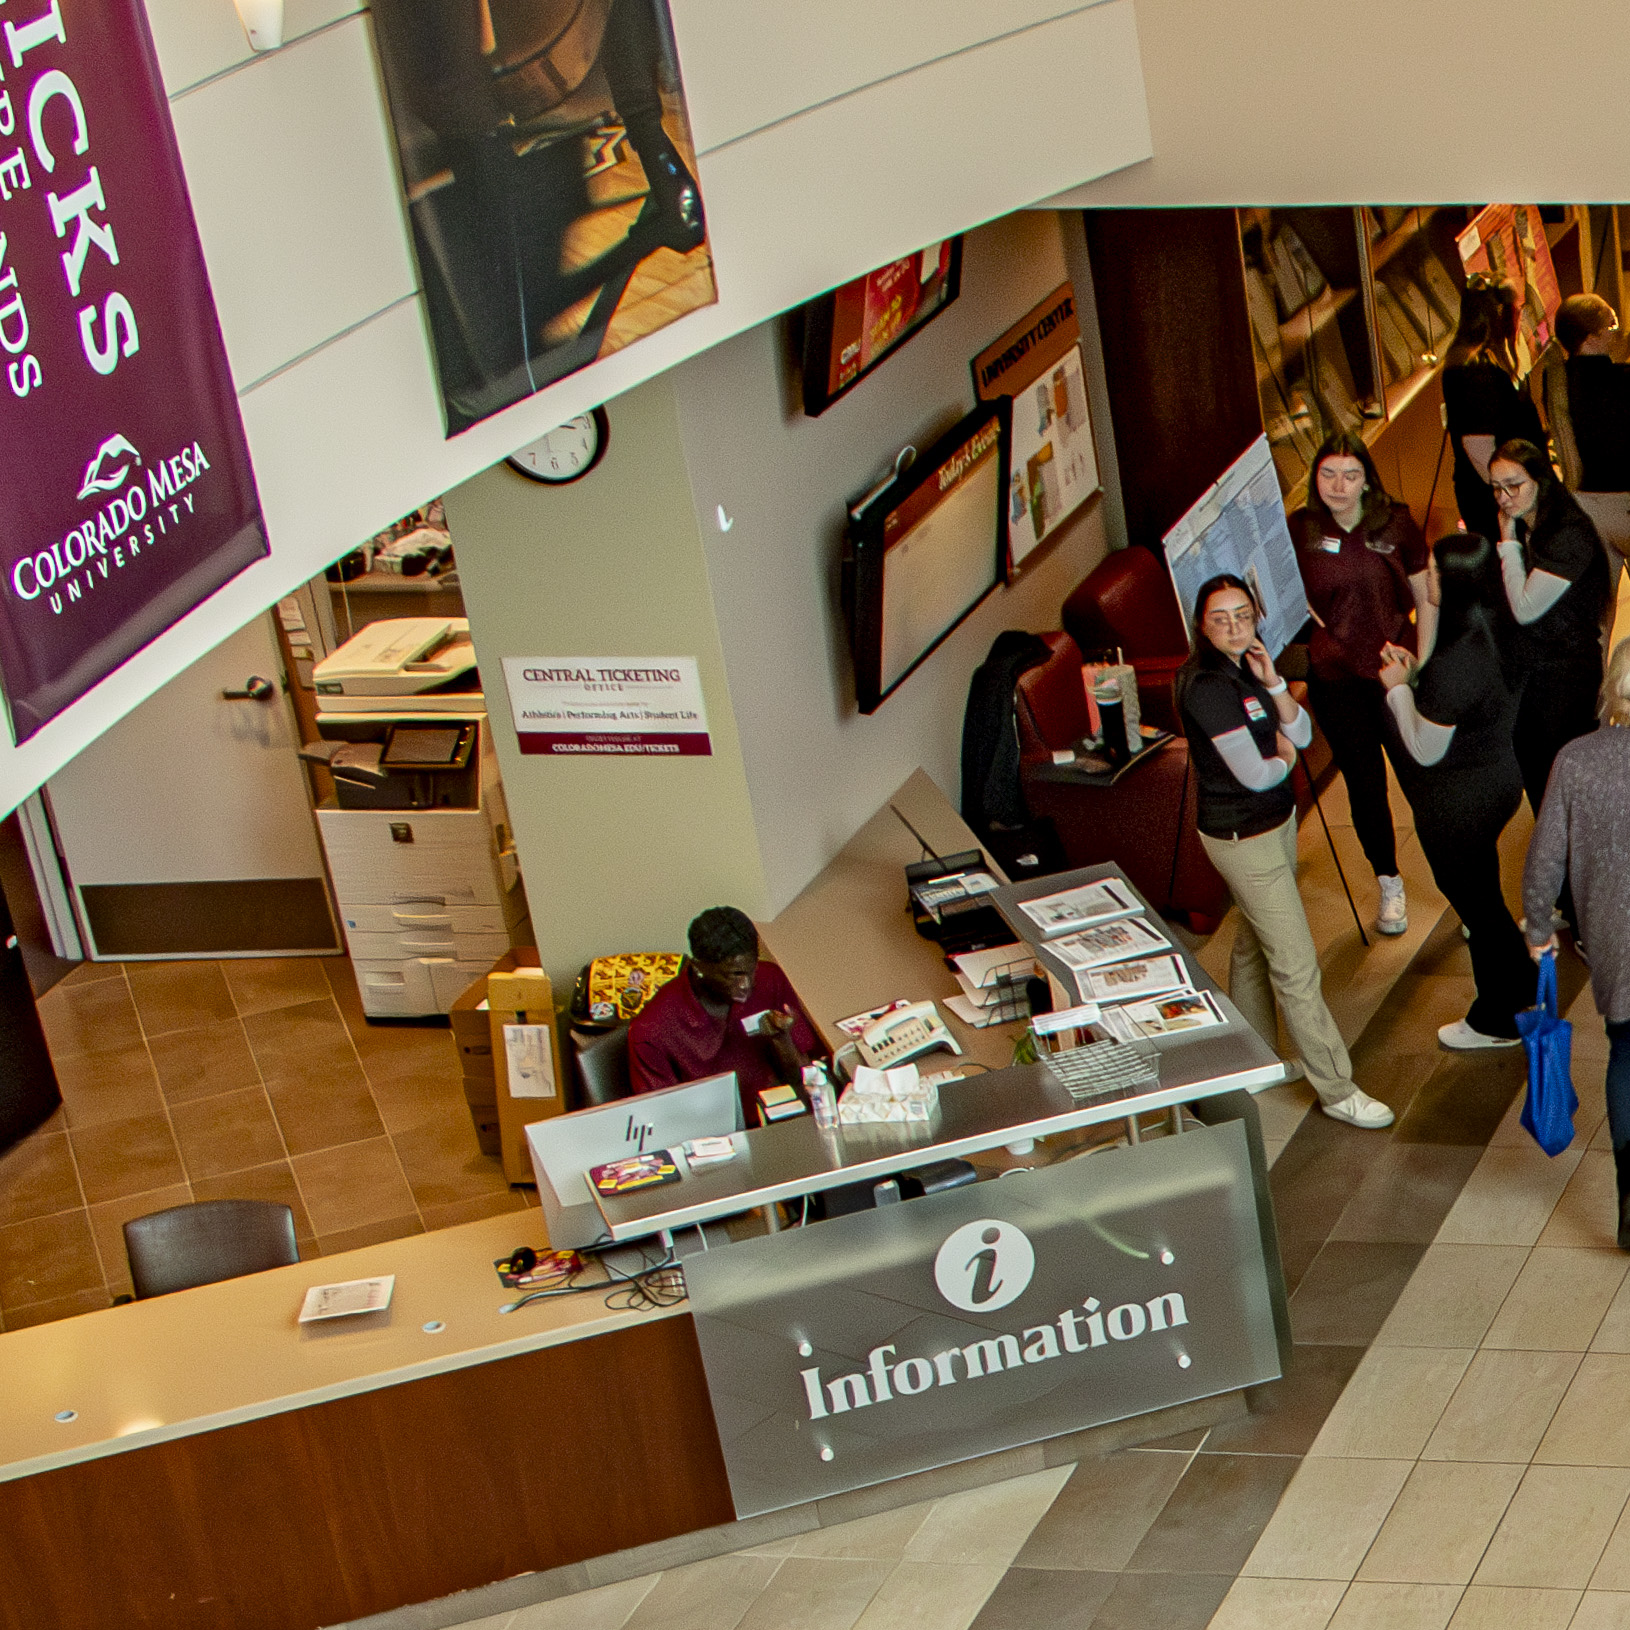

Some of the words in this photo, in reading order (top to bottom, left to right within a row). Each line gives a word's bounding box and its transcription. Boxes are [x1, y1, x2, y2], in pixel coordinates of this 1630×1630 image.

[2, 0, 140, 375] ICKS
[12, 485, 147, 601] COLORADO
[147, 440, 211, 508] MESA
[49, 492, 195, 615] UNIVERSITY
[522, 668, 596, 683] CENTRAL
[596, 668, 682, 683] TICKETING
[583, 683, 626, 693] OFFICE
[800, 1292, 1190, 1420] Information
